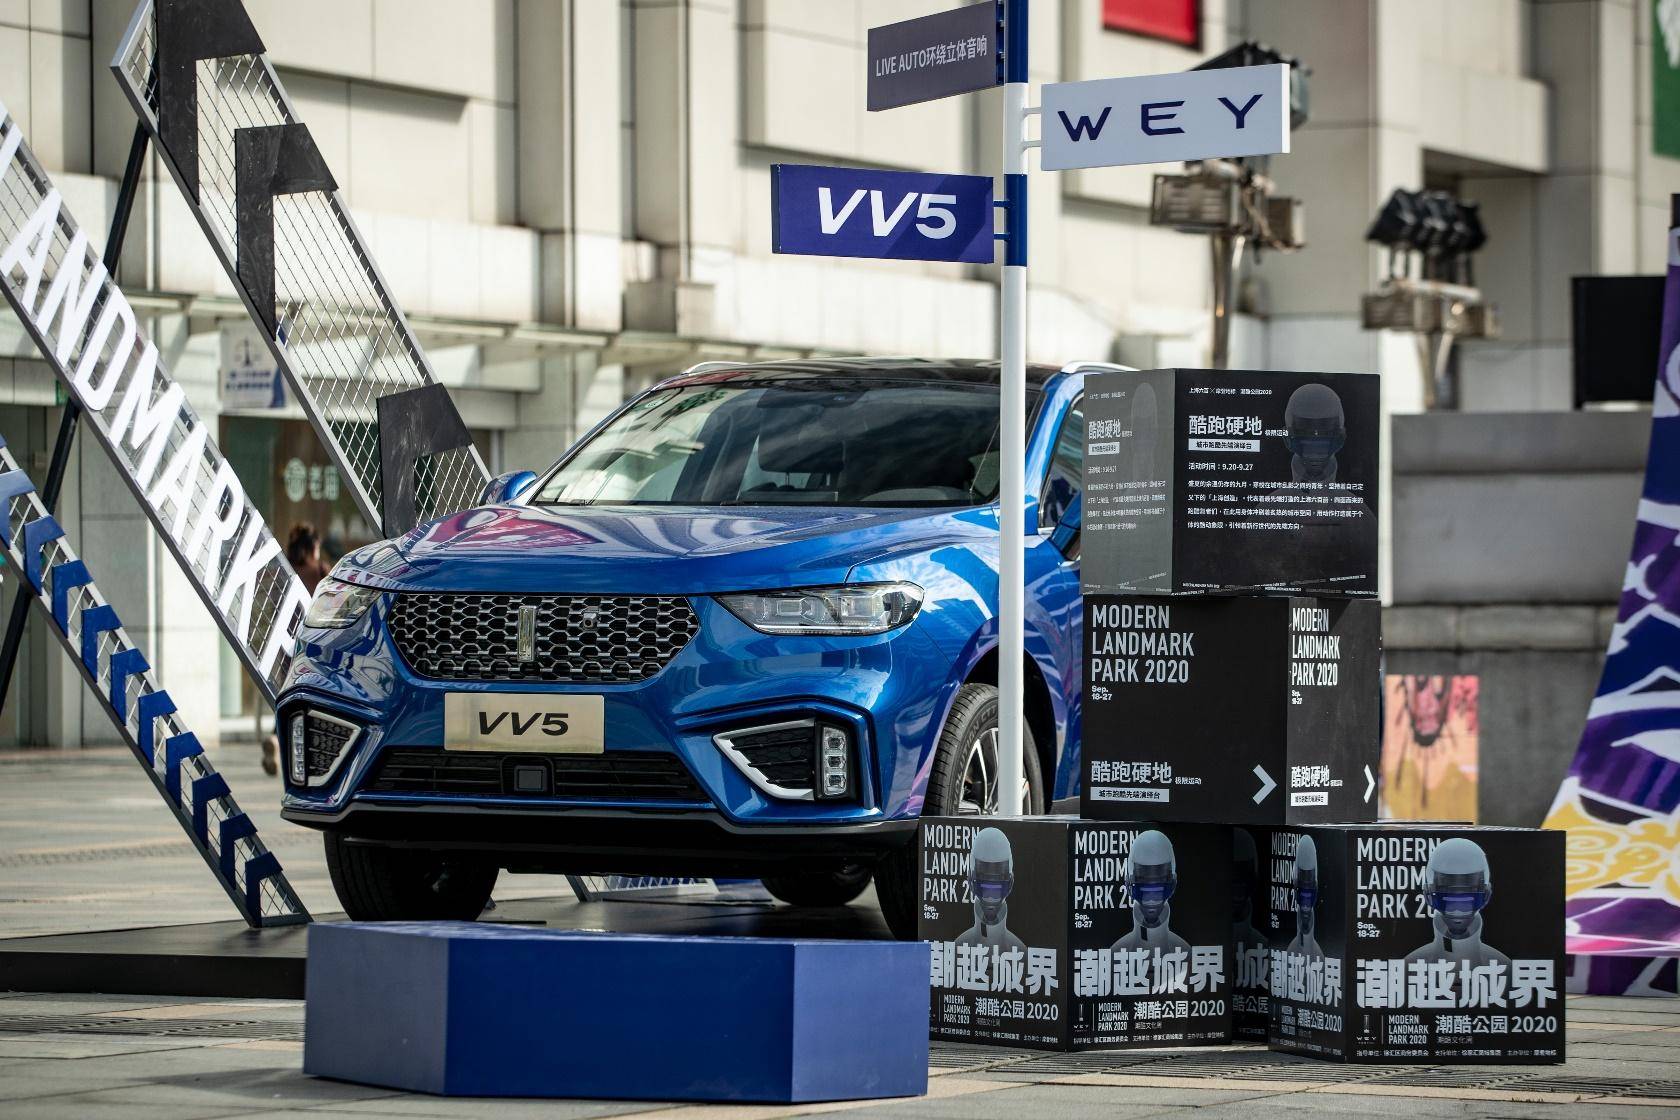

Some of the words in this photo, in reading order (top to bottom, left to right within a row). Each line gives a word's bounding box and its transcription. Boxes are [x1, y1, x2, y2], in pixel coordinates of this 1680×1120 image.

[876, 56, 897, 77] LIVE
[1057, 94, 1263, 142] WEY
[818, 187, 957, 239] VV5
[0, 123, 283, 645] ANDMARK
[1188, 415, 1262, 436] 酷跑硬地
[1092, 605, 1170, 629] MODERN
[1292, 608, 1329, 632] MODERN
[1092, 632, 1194, 656] LANDMARK
[1292, 636, 1340, 660] LANDMARK
[1091, 659, 1139, 683] PARK
[1145, 659, 1189, 683] 2020
[1292, 662, 1315, 686] PARK
[1317, 663, 1338, 686] 2020
[1091, 685, 1109, 693] Sep.
[1091, 693, 1112, 701] 18-27
[478, 712, 570, 736] VV5
[1091, 761, 1172, 784] 酷跑硬地
[1291, 765, 1329, 788] 酷跑硬地
[924, 851, 971, 876] LANDM
[1074, 857, 1128, 882] LANDM
[923, 878, 958, 902] PARK
[1357, 866, 1426, 890] LANDM
[923, 904, 936, 913] Sep.
[1074, 885, 1115, 910] PARK
[1271, 886, 1290, 911] PARK
[1357, 894, 1409, 918] PARK
[923, 912, 939, 920] 18-27
[1074, 913, 1090, 921] Sep.
[1357, 921, 1376, 930] Sep.
[1357, 930, 1380, 938] 18-27
[1073, 945, 1225, 998] 潮越城界
[1270, 949, 1342, 1008] 潮越城界
[1356, 959, 1557, 1009] 潮越城界
[1098, 1003, 1122, 1011] MODERN
[1098, 1012, 1129, 1022] LANDMARK
[1388, 1014, 1420, 1024] MODERN
[1098, 1021, 1113, 1031] PARK
[1114, 1021, 1127, 1031] 2020
[1388, 1025, 1429, 1034] LANDMARK
[1388, 1035, 1408, 1044] PARK
[1409, 1035, 1427, 1044] 2020
